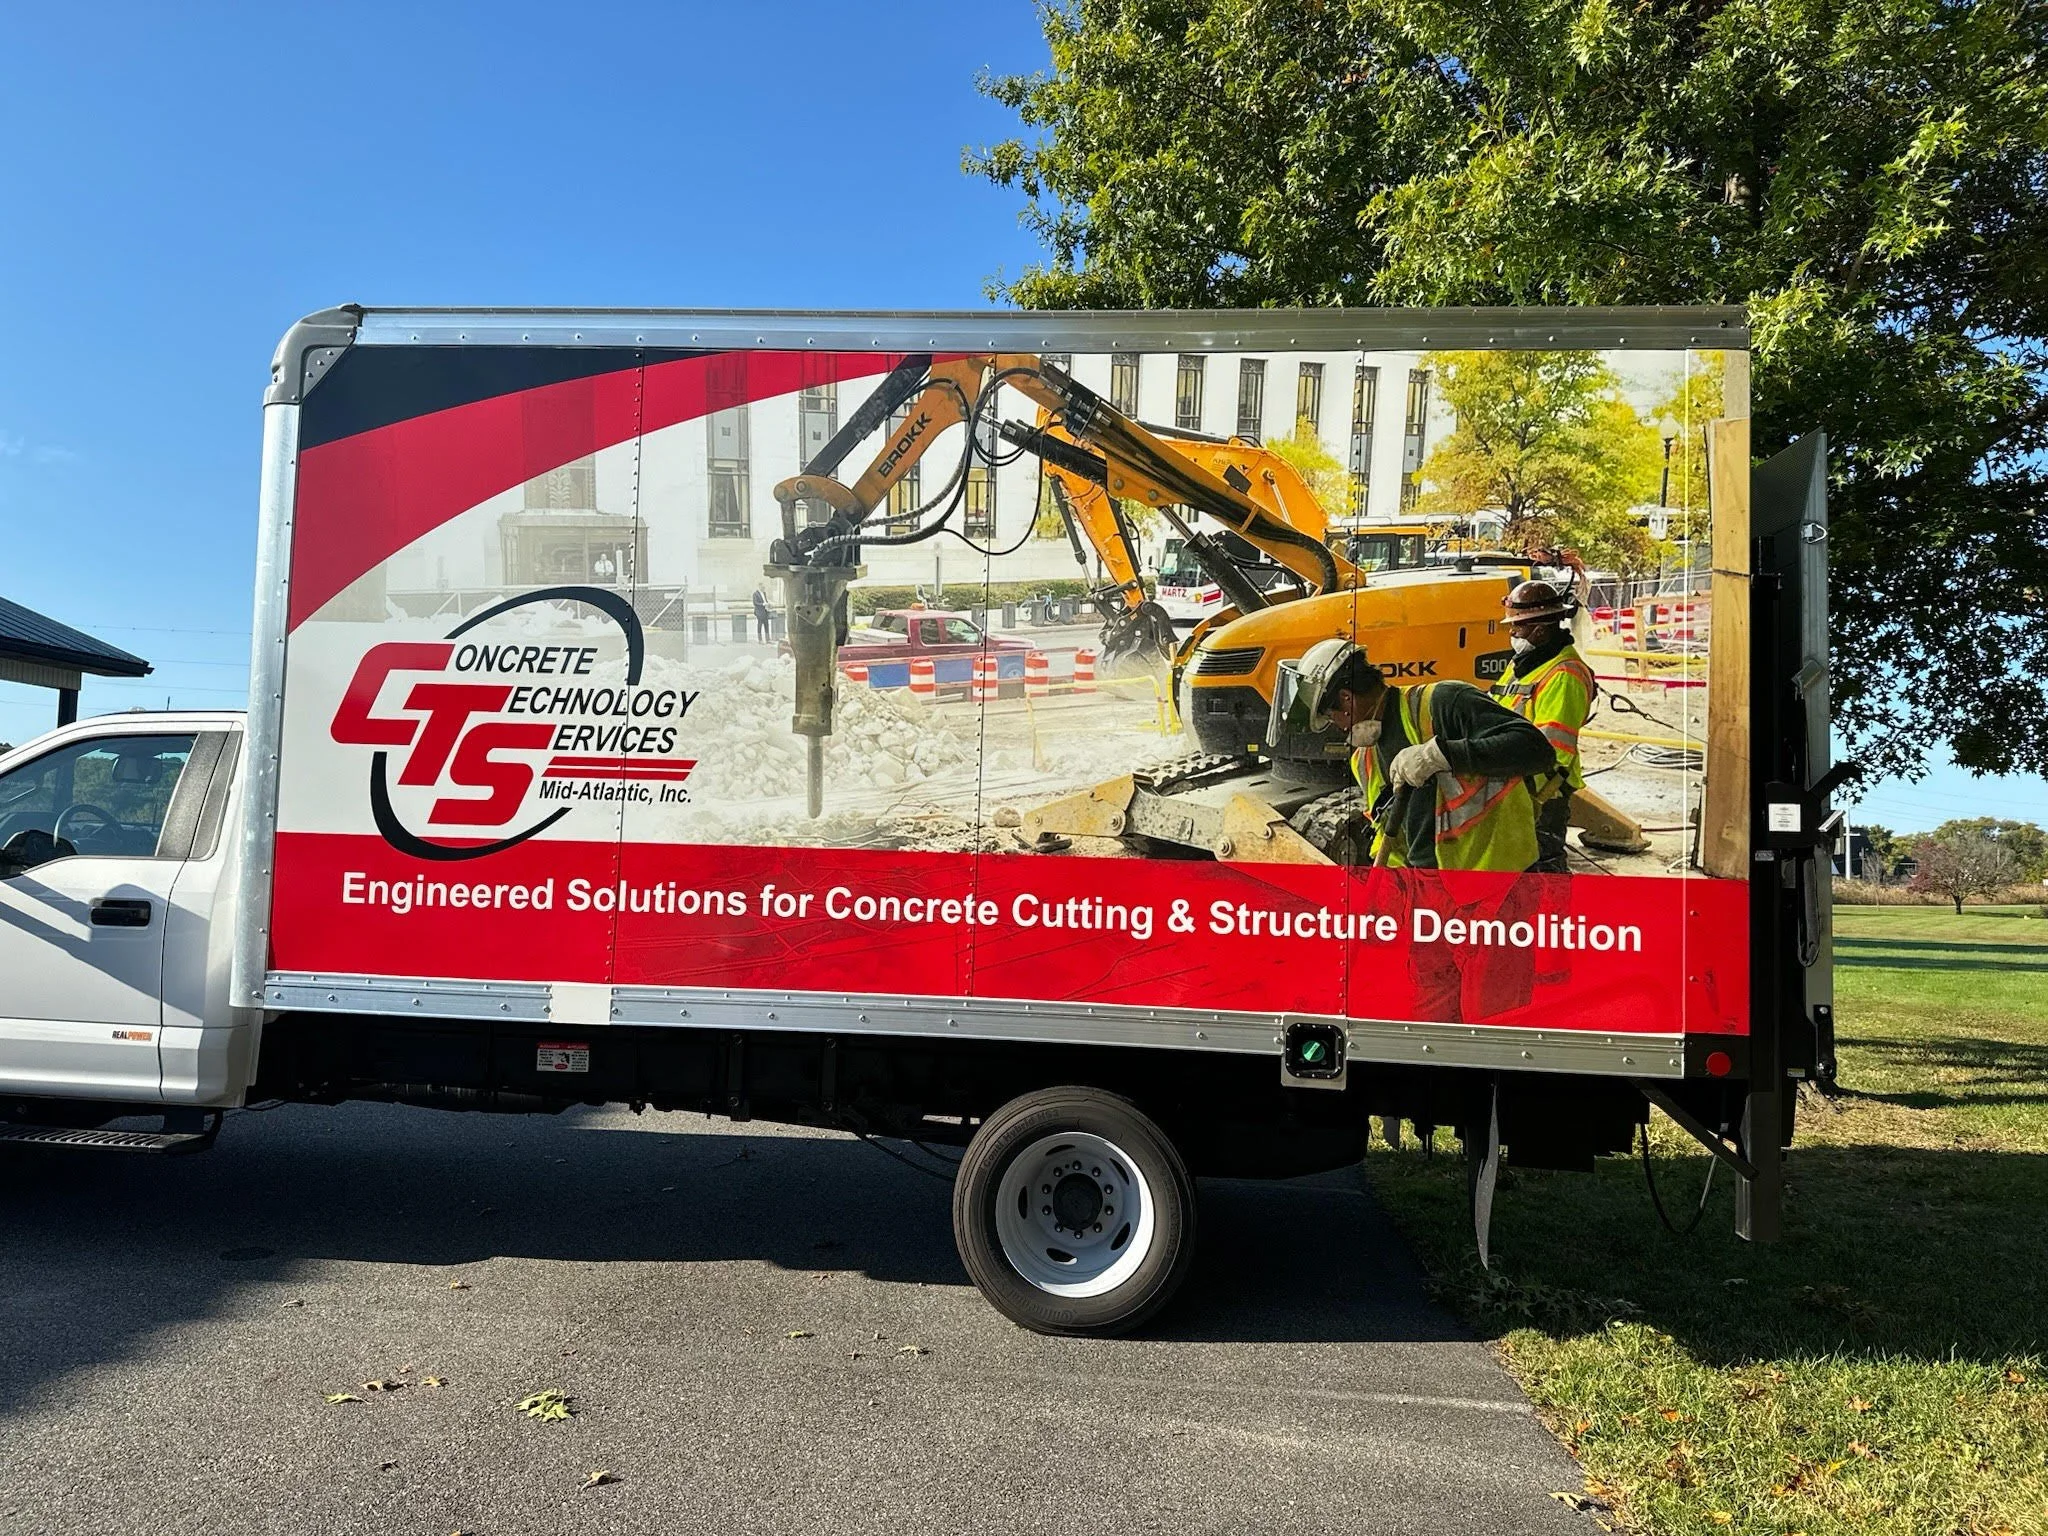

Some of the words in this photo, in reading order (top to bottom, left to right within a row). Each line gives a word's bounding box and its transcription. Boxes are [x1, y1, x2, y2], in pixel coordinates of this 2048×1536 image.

[877, 411, 933, 478] BROKK
[1161, 587, 1188, 598] MARTZ
[455, 644, 598, 675] ONCRETE
[1379, 661, 1438, 678] OKK
[507, 686, 700, 719] ECHNOLOGY
[552, 724, 678, 754] ERVICES
[539, 780, 654, 805] Mid-Atlantic,
[660, 784, 692, 804] Inc.
[342, 871, 554, 914] Engineered
[566, 878, 747, 917] Solutions
[760, 884, 814, 918] for
[825, 886, 999, 926] Concrete
[1012, 893, 1153, 940] Cutting
[1167, 898, 1197, 933] &
[1209, 900, 1398, 942] Structure
[1413, 908, 1643, 952] Demolition
